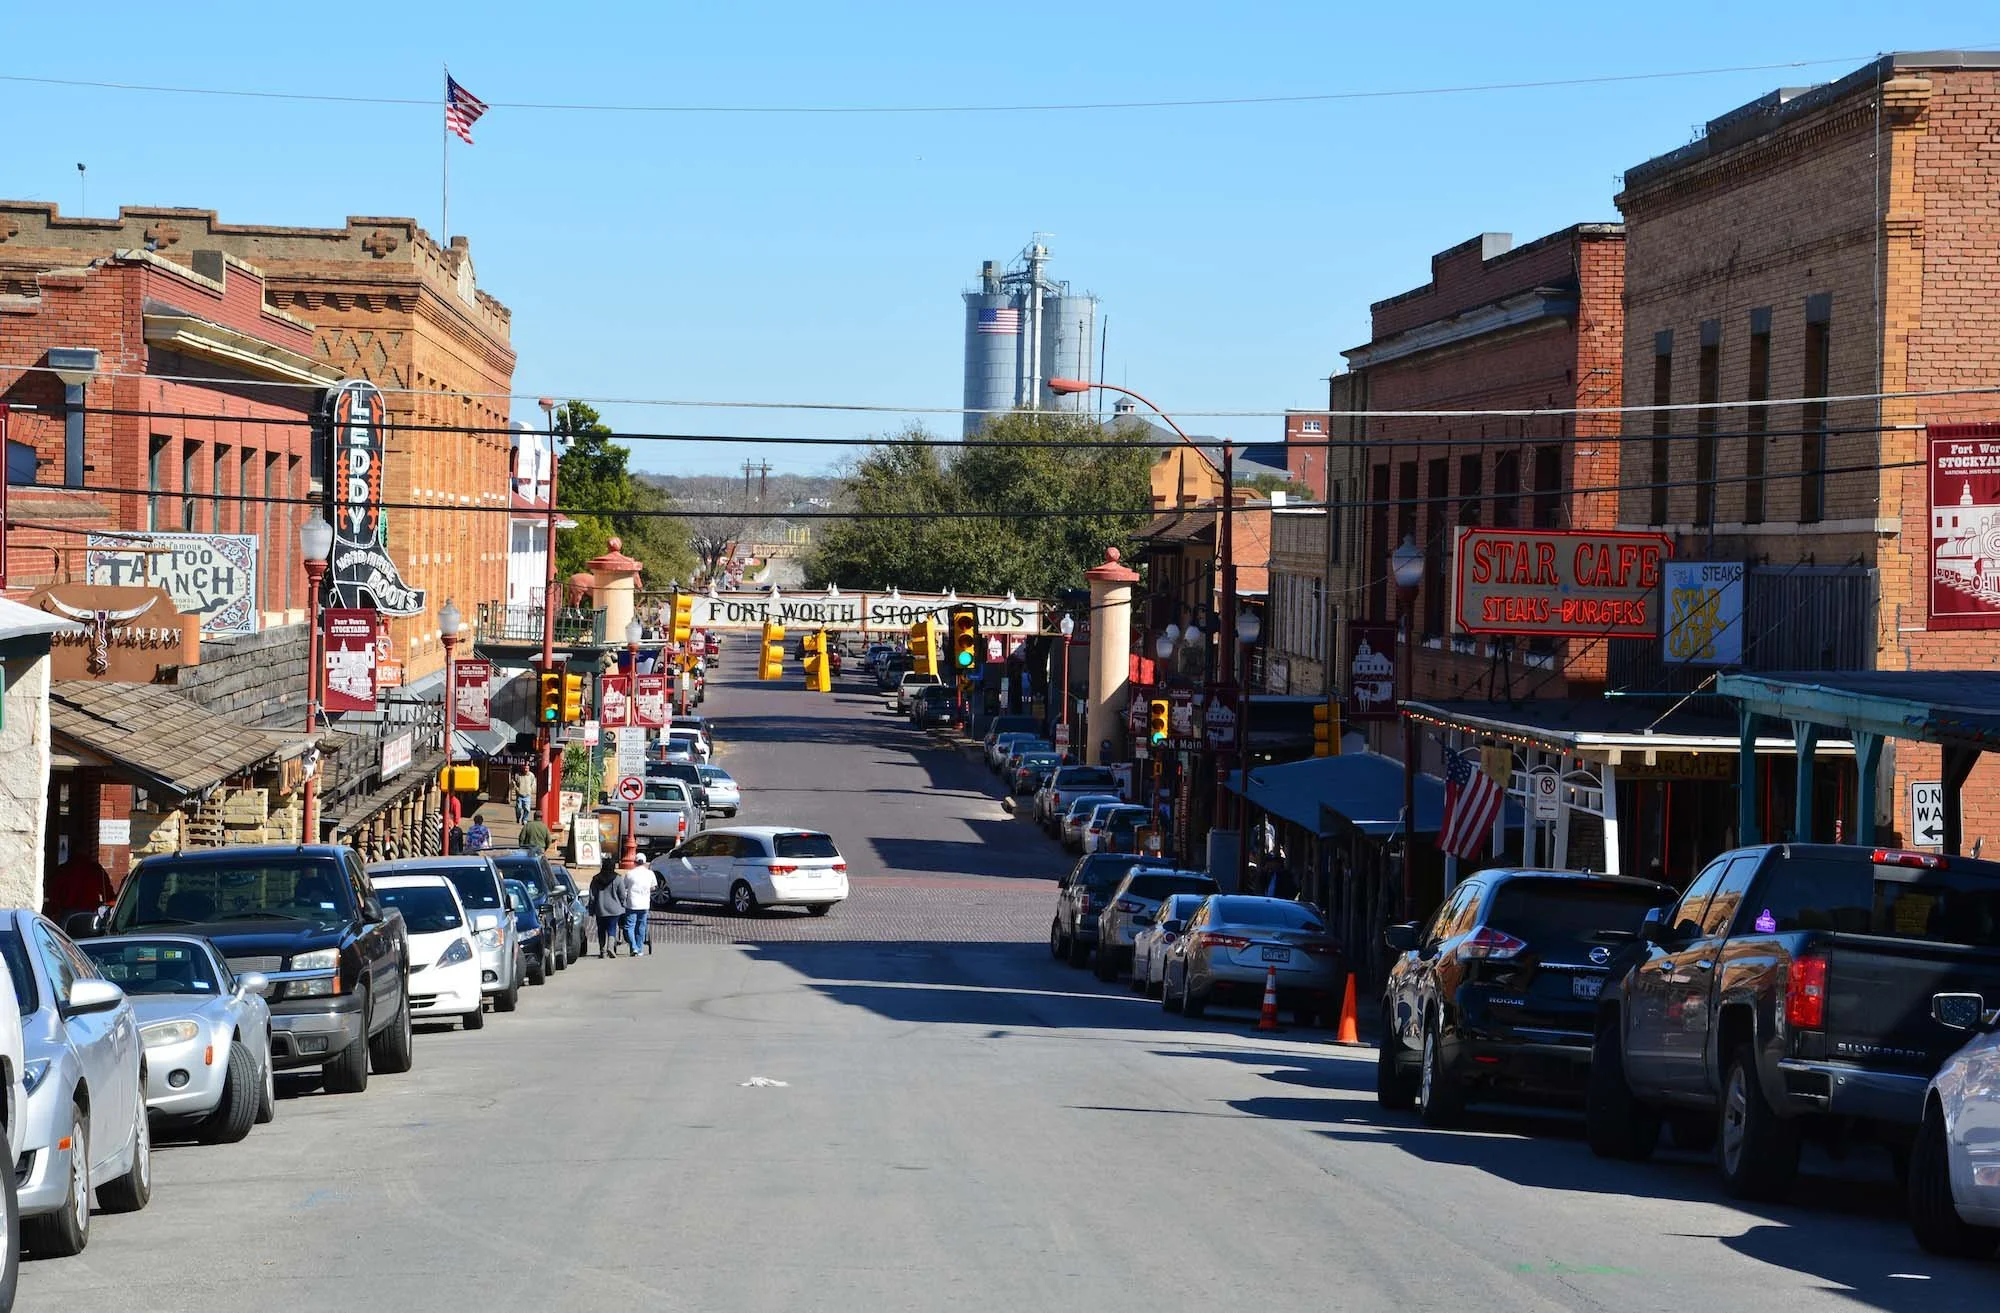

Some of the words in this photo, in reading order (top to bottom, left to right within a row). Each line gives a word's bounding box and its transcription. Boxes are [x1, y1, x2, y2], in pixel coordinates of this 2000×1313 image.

[1979, 443, 2000, 453] Wor
[348, 390, 370, 535] LEDDY
[1938, 456, 2000, 468] STOCKYA
[169, 541, 202, 551] famous
[98, 550, 213, 586] TATTOO
[1472, 539, 1559, 585] STAR
[1574, 542, 1660, 588] CAFE
[1702, 565, 1742, 581] STEAKS
[159, 566, 234, 596] ANCH
[367, 568, 418, 611] BOOTS
[708, 602, 769, 622] FORT
[780, 603, 855, 623] WORTH
[872, 605, 1025, 627] STOCKRDS
[1671, 587, 1727, 630] STAR
[112, 626, 182, 642] WINERY
[1669, 627, 1717, 659] CAFE
[1168, 740, 1175, 749] N
[1180, 740, 1202, 750] Main
[1917, 789, 1941, 804] ON
[1917, 807, 1944, 822] WA
